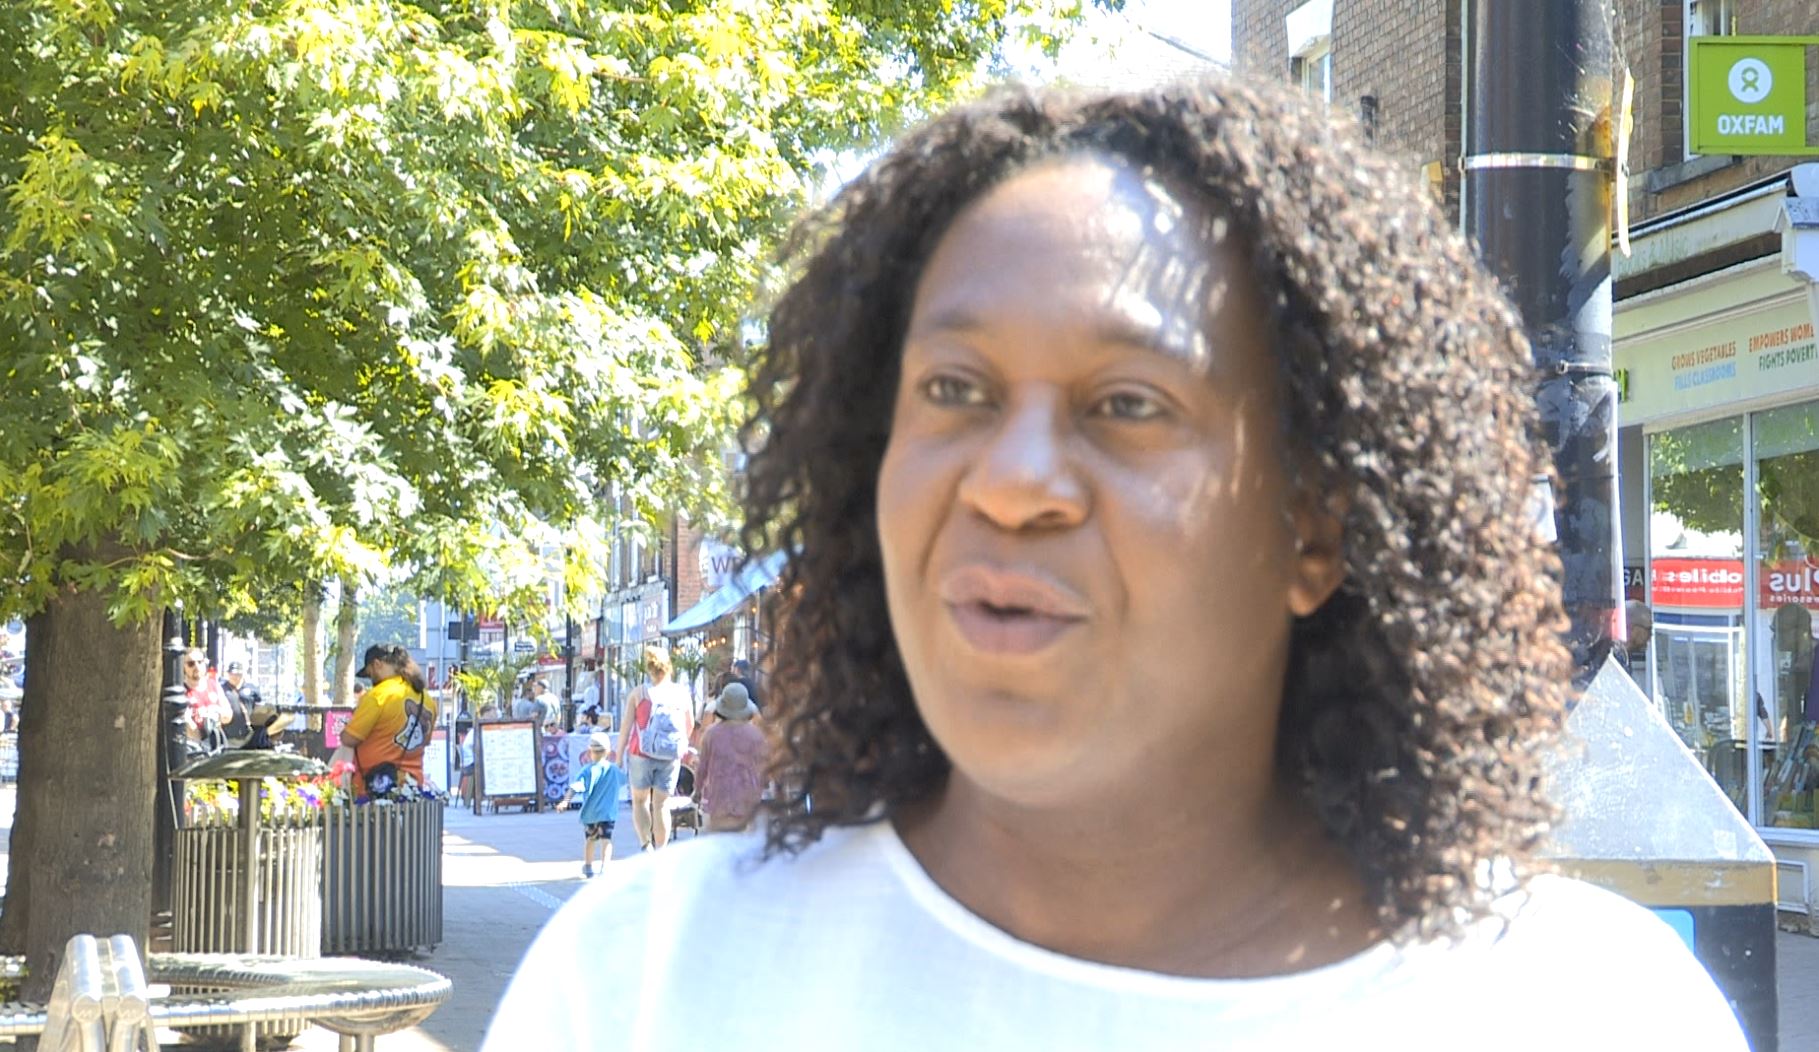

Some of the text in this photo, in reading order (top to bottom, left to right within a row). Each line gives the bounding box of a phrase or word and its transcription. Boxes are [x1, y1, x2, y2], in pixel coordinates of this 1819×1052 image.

[1717, 115, 1784, 134] OXFAM
[1749, 327, 1789, 353] EMPOWERS
[1672, 341, 1736, 371] GROWS VEGETABLES
[1759, 350, 1785, 372] FIGHTS
